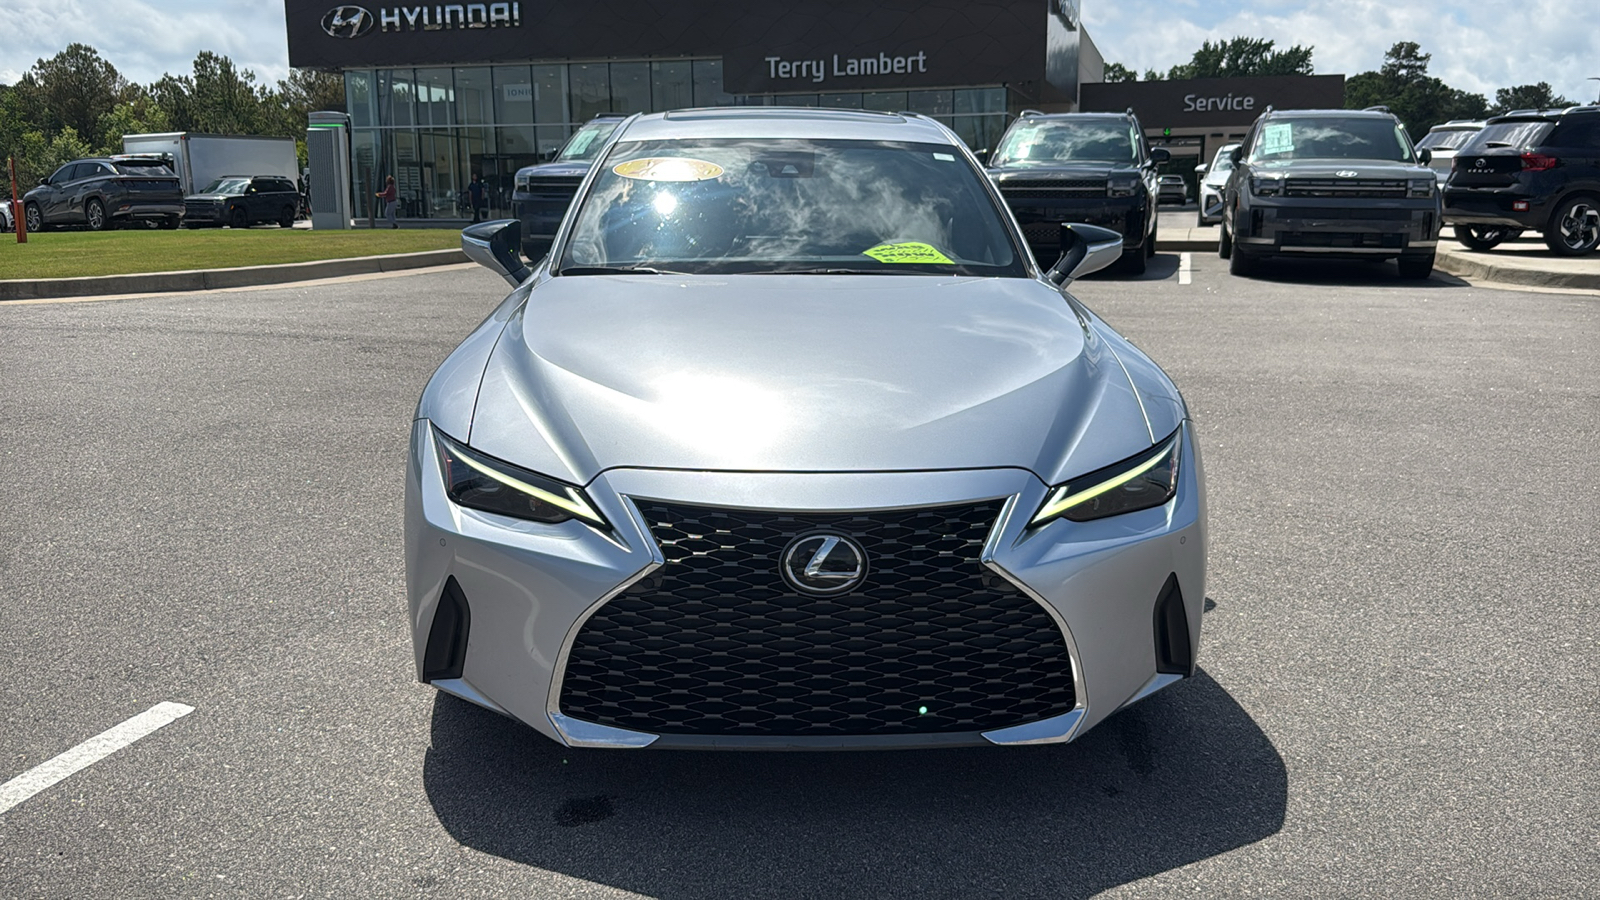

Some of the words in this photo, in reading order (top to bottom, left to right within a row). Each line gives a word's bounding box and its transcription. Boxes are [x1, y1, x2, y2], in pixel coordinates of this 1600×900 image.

[380, 2, 520, 32] HYUNDAI
[765, 57, 825, 82] Terry
[833, 51, 927, 76] Lambert
[1183, 93, 1255, 111] Service
